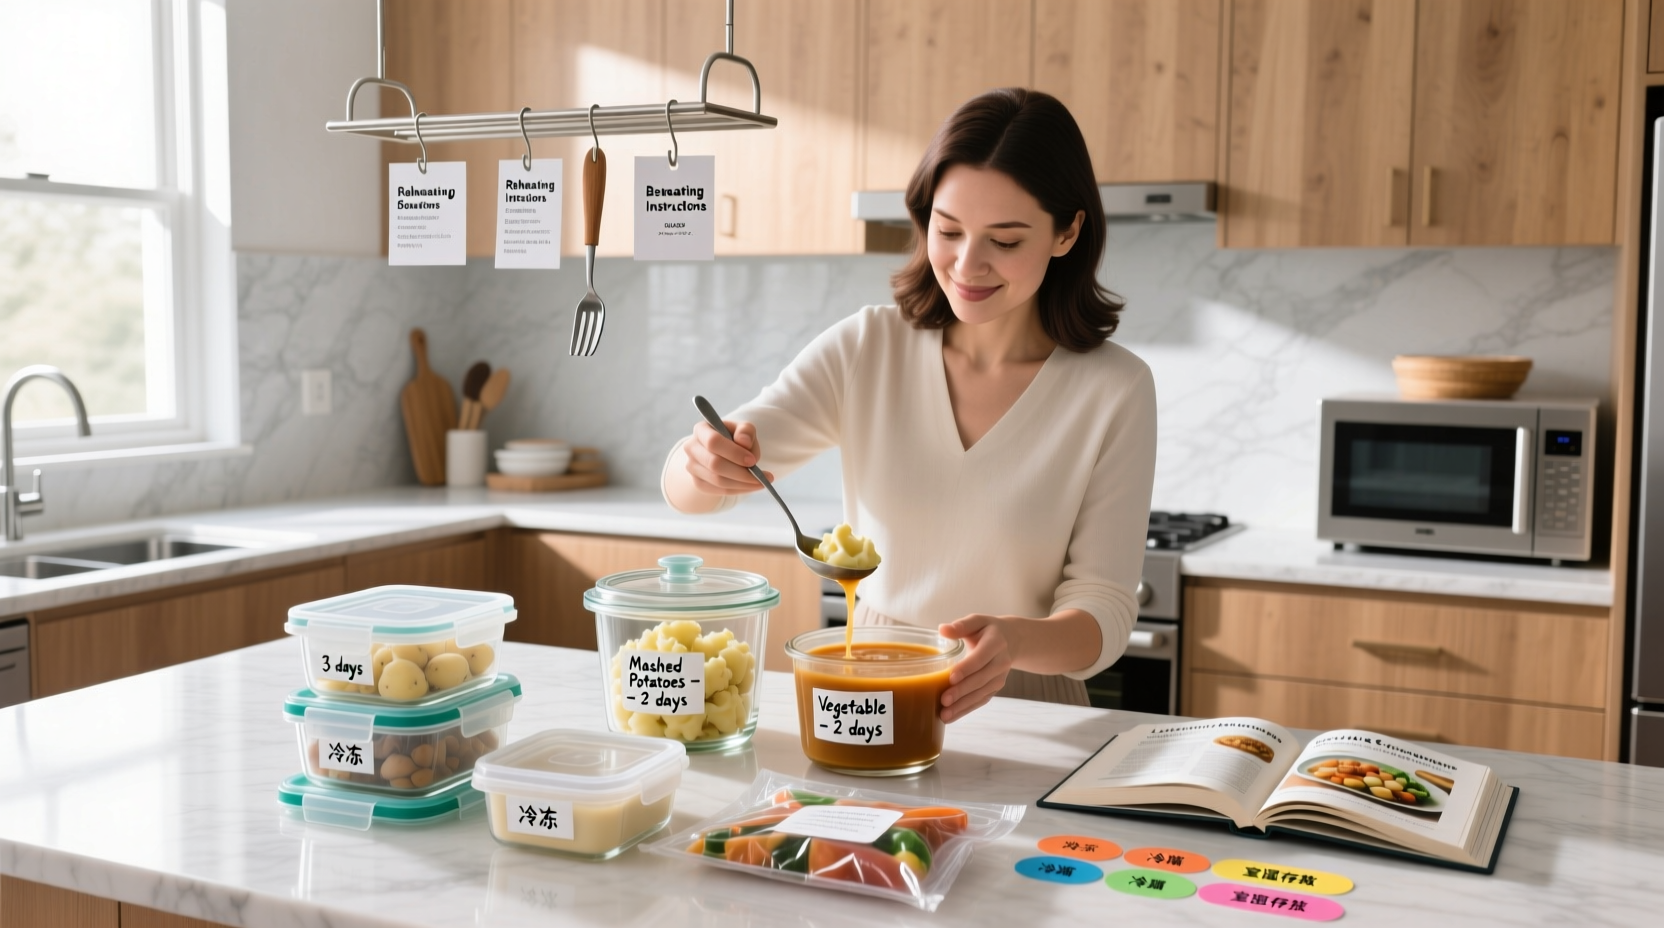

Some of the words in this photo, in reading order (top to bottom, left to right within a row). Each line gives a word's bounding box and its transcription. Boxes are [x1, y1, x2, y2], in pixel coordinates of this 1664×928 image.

[322, 654, 331, 673] 3
[335, 655, 363, 681] days
[629, 655, 683, 673] Mashed
[629, 672, 686, 688] Potatoes
[640, 691, 649, 705] 2
[655, 690, 688, 714] days
[818, 695, 887, 719] Vegetable
[833, 719, 842, 734] 2
[848, 719, 883, 743] days
[328, 742, 363, 766] 冷冻
[518, 804, 558, 830] 冷冻
